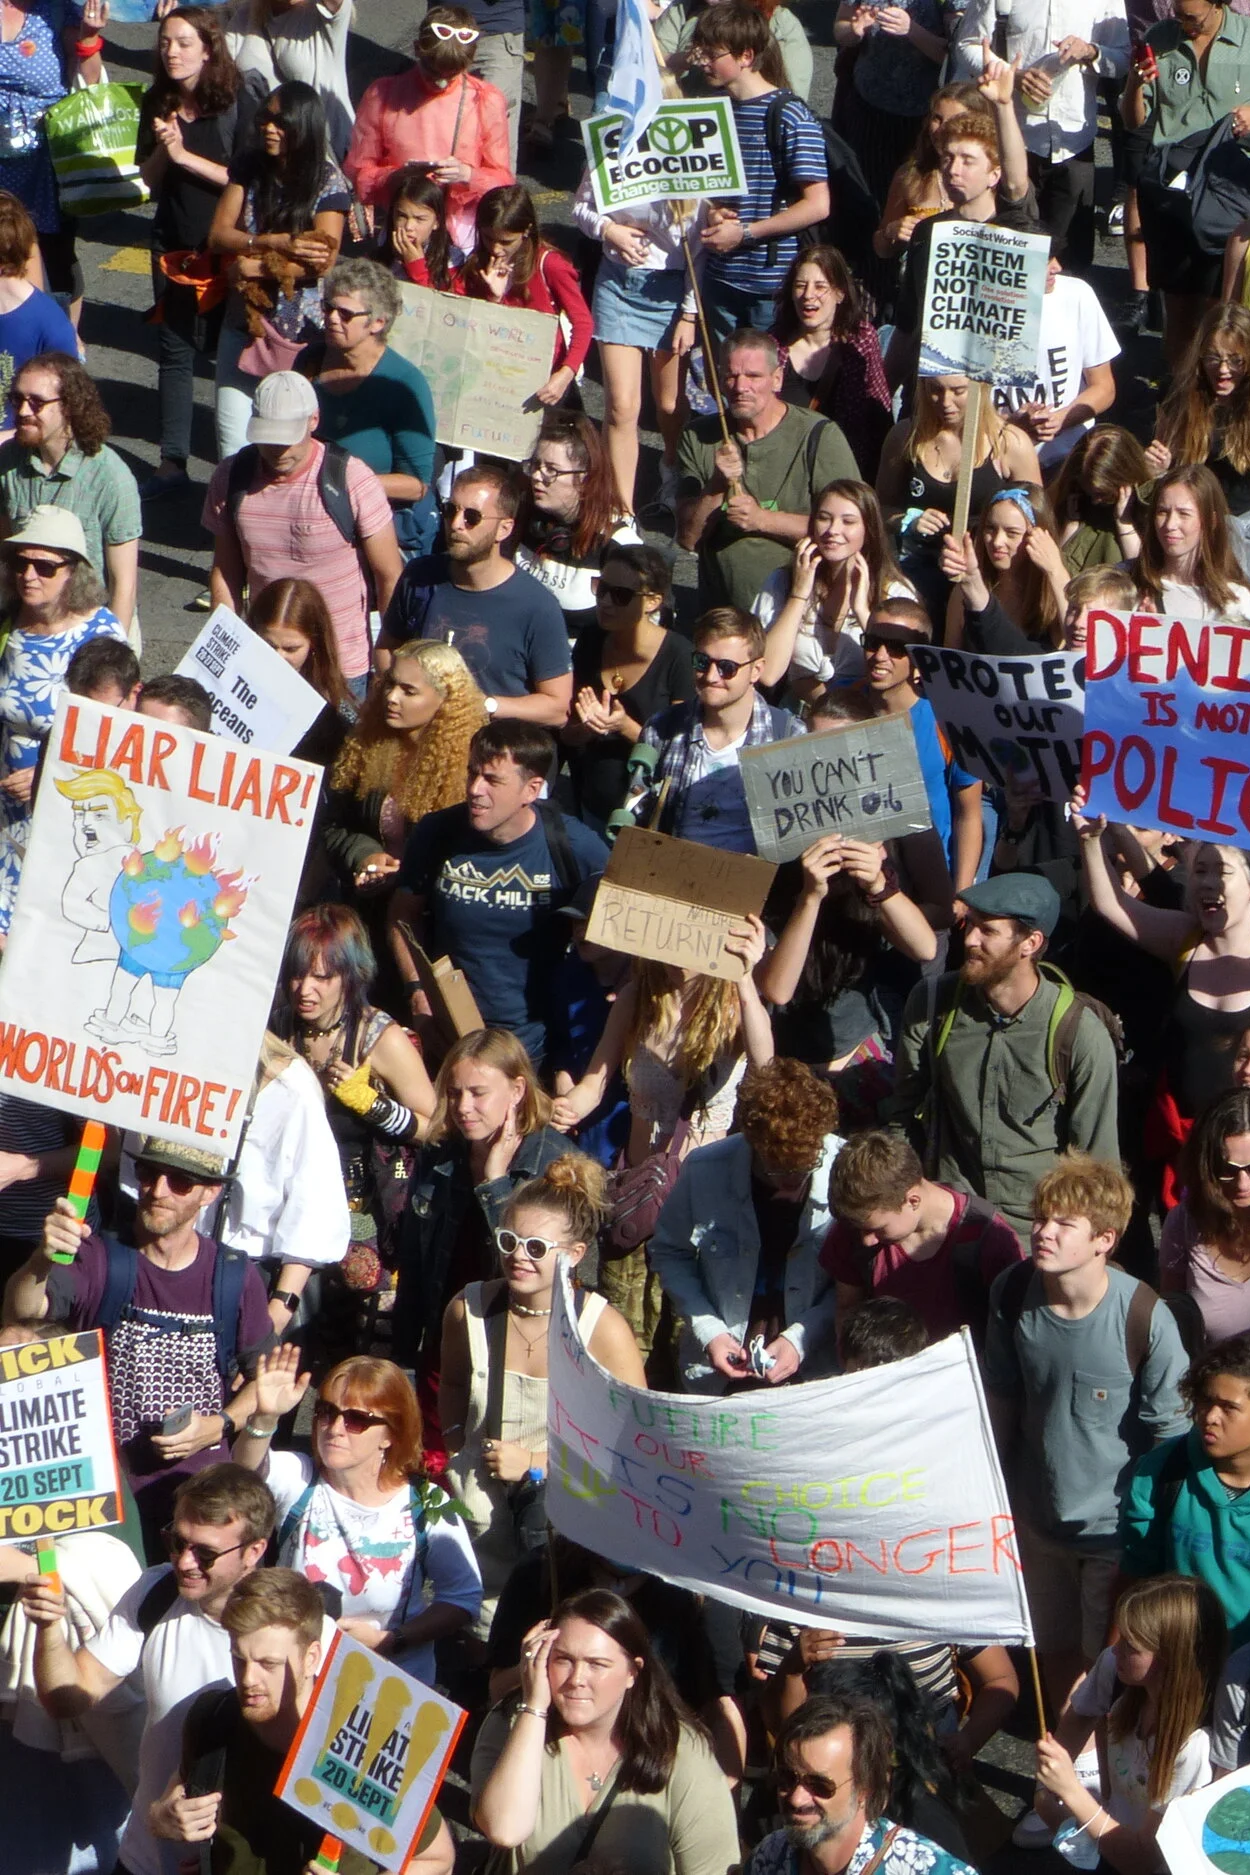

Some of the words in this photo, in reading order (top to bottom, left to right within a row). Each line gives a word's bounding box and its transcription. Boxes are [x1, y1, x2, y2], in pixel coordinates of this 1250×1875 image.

[57, 107, 140, 131] WAOSE
[609, 153, 725, 184] ECOCIDE
[609, 178, 671, 203] change
[673, 177, 700, 191] the
[704, 175, 732, 189] law
[952, 226, 994, 241] Socialist
[993, 234, 1029, 248] Worker
[936, 242, 1025, 271] SYSTEM
[933, 278, 978, 296] NOT
[934, 260, 1028, 290] CHANGE
[443, 312, 479, 332] OUR
[931, 296, 1027, 325] CLIMATE
[930, 314, 1023, 341] CHANGE
[461, 423, 523, 447] FUTURE
[206, 637, 232, 664] STRIKE
[211, 624, 241, 655] CLIMATE
[911, 647, 1087, 701] PROTE
[231, 675, 258, 711] The
[1140, 692, 1178, 727] IS
[208, 691, 255, 744] oceans
[994, 704, 1063, 733] our
[59, 705, 178, 791] LIAR
[187, 741, 316, 827] LIAR!
[765, 769, 803, 799] YOU
[811, 750, 884, 796] CAN'T
[774, 795, 853, 839] DRINK
[495, 890, 551, 906] HILLS
[0, 1021, 122, 1104] WORLD'S
[141, 1066, 243, 1139] FIRE!
[0, 1334, 86, 1381] ICK
[0, 1371, 81, 1396] LOBAL
[0, 1388, 87, 1432] LIMATE
[609, 1388, 778, 1451] FUTURE
[0, 1424, 82, 1468] STRIKE
[1, 1475, 29, 1501] 20
[34, 1464, 83, 1496] SEPT
[634, 1433, 717, 1479] OUR
[741, 1466, 927, 1510] CHOICE
[621, 1489, 682, 1547] TO
[721, 1497, 819, 1545] NO
[769, 1513, 1023, 1576] LONGER
[320, 1759, 348, 1788] 20
